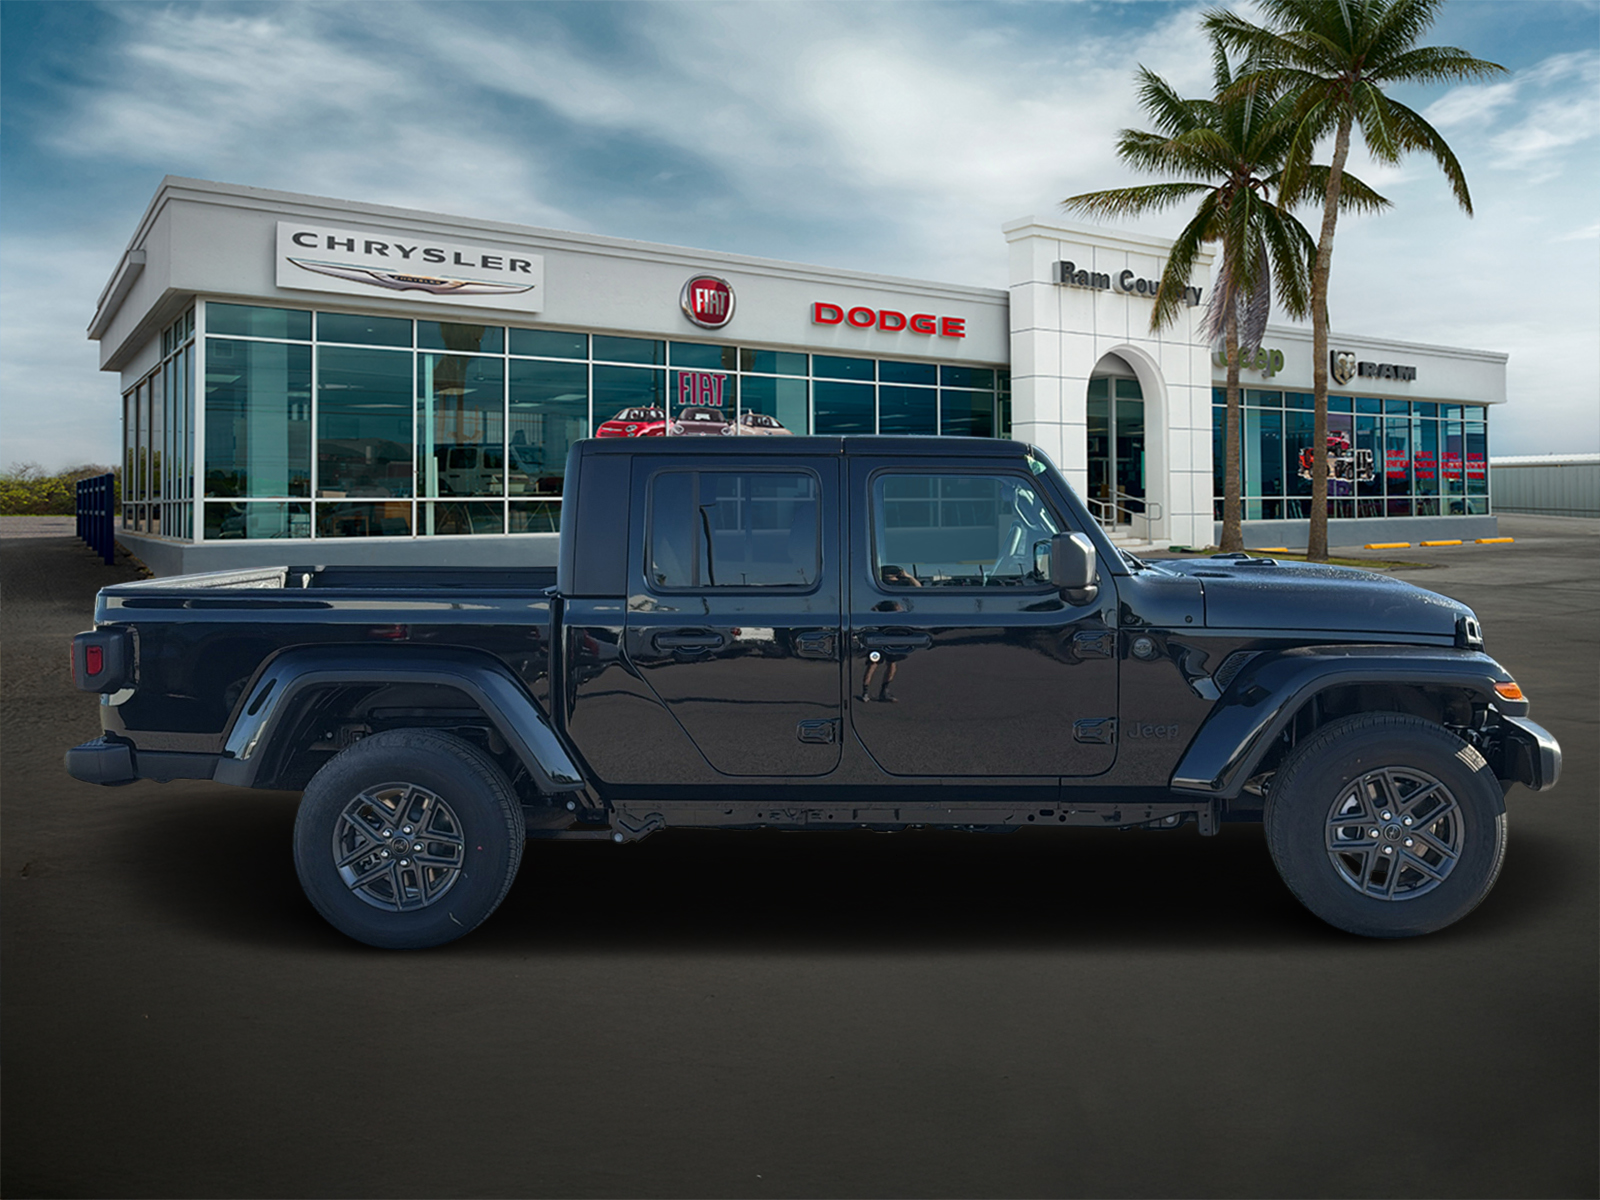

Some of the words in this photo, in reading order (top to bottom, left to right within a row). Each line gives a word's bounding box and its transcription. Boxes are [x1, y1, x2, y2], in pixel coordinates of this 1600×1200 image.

[292, 231, 533, 274] CHRYSLER
[694, 287, 728, 316] FIAT
[1057, 260, 1111, 290] Ram
[1117, 269, 1203, 307] Coury
[811, 301, 966, 338] DODGE
[678, 371, 727, 408] FIAT
[1359, 361, 1417, 381] RAM
[1127, 722, 1180, 740] Jeep
